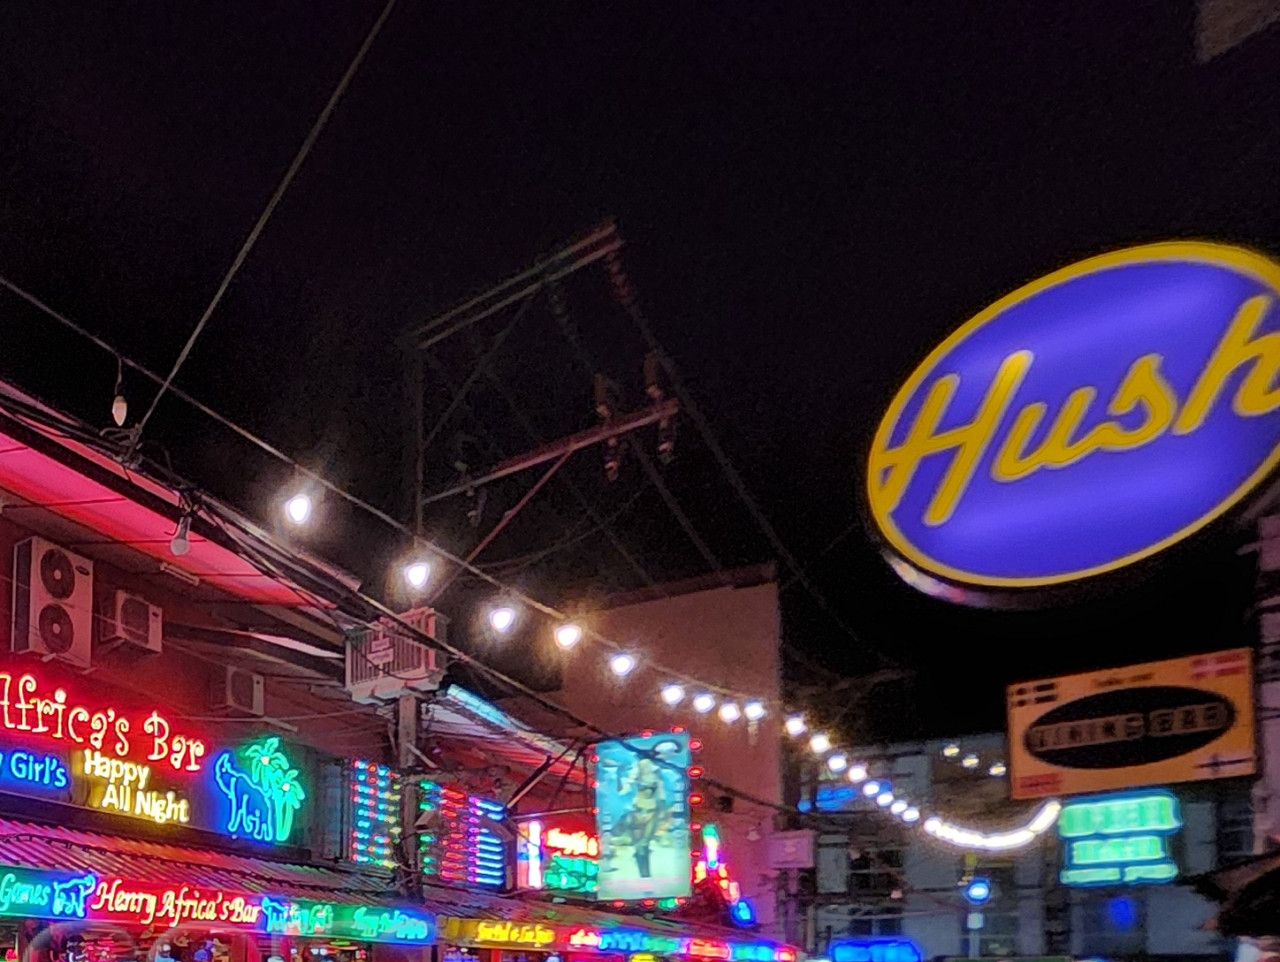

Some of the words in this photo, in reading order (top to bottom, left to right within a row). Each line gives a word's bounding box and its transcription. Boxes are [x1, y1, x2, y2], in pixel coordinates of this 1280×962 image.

[877, 294, 1280, 526] Hush
[144, 710, 204, 771] Bar
[11, 752, 68, 788] Girl's
[84, 749, 150, 789] Happy
[102, 784, 131, 811] All
[135, 791, 189, 823] Night
[91, 880, 158, 924] Henry
[156, 887, 230, 927] Africa's
[230, 897, 262, 923] Bar
